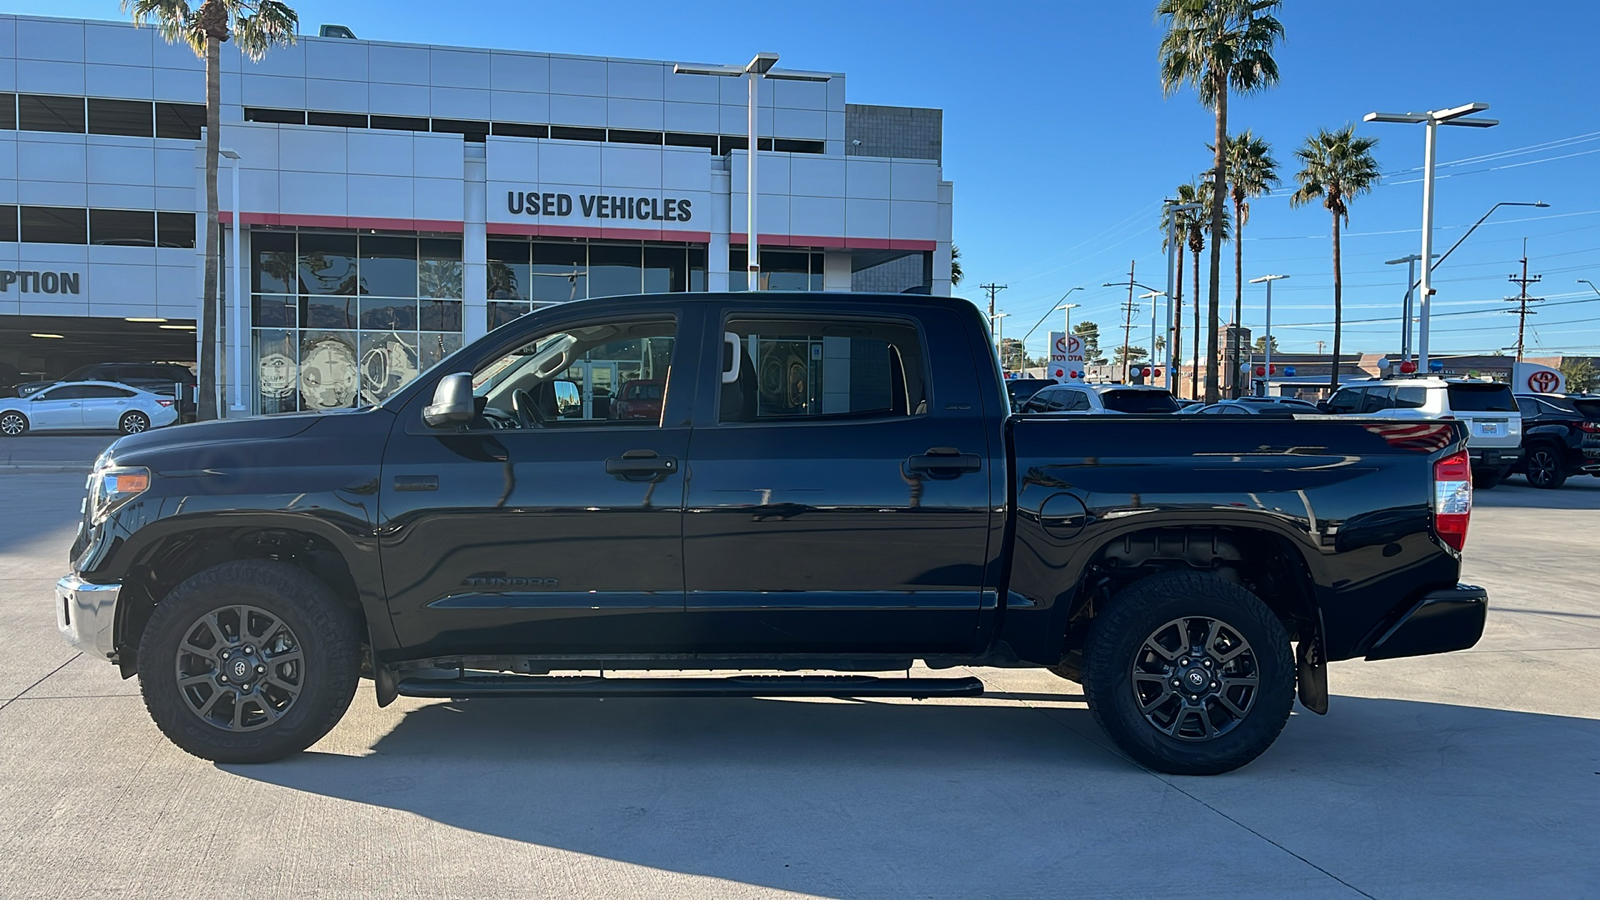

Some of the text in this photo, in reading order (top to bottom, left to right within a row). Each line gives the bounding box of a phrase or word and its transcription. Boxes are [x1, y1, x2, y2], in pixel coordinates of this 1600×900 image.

[508, 191, 692, 222] USED VEHICLES
[0, 270, 79, 294] PTION
[464, 576, 560, 589] TUNDRA
